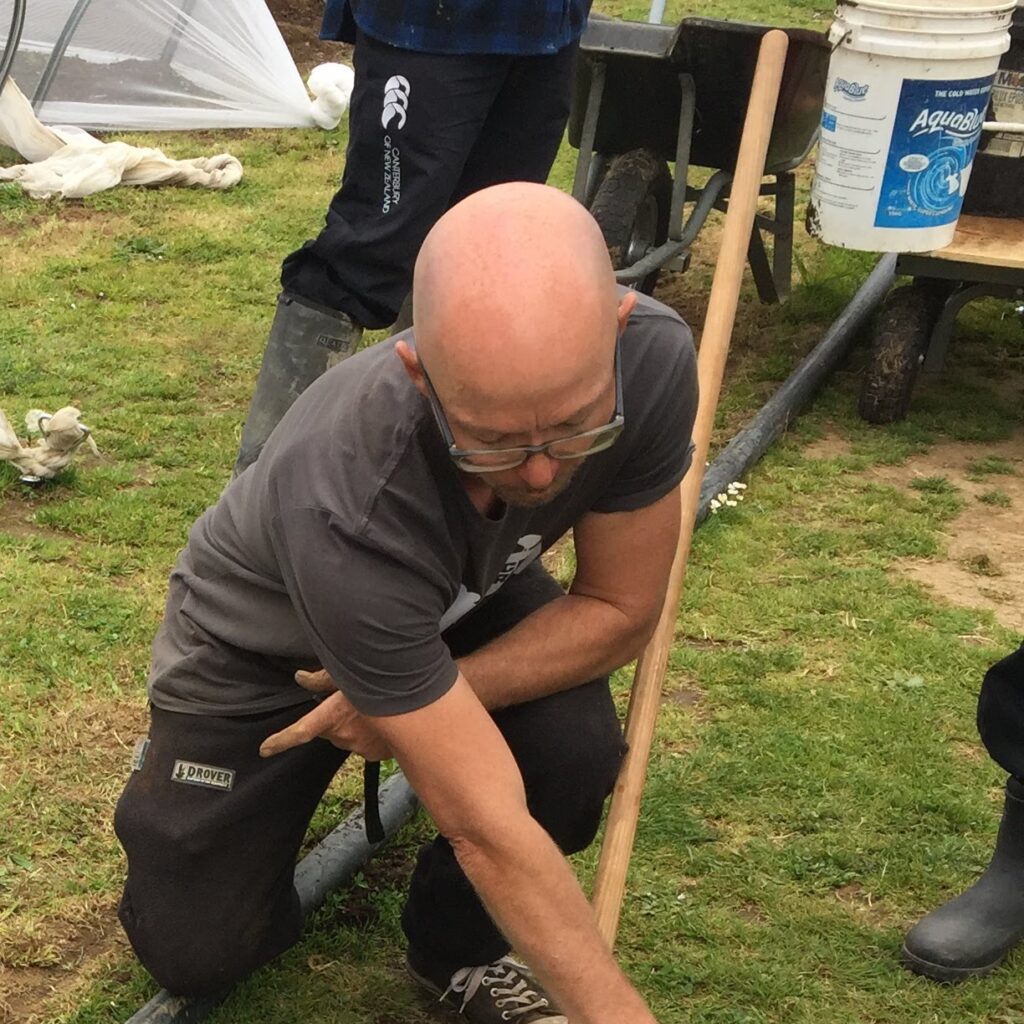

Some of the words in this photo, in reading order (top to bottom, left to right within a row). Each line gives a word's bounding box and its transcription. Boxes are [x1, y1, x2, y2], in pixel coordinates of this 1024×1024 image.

[384, 135, 391, 148] OF
[392, 147, 400, 204] CANTERBURY
[382, 172, 391, 213] ZEALAND
[188, 766, 231, 783] DROVER
